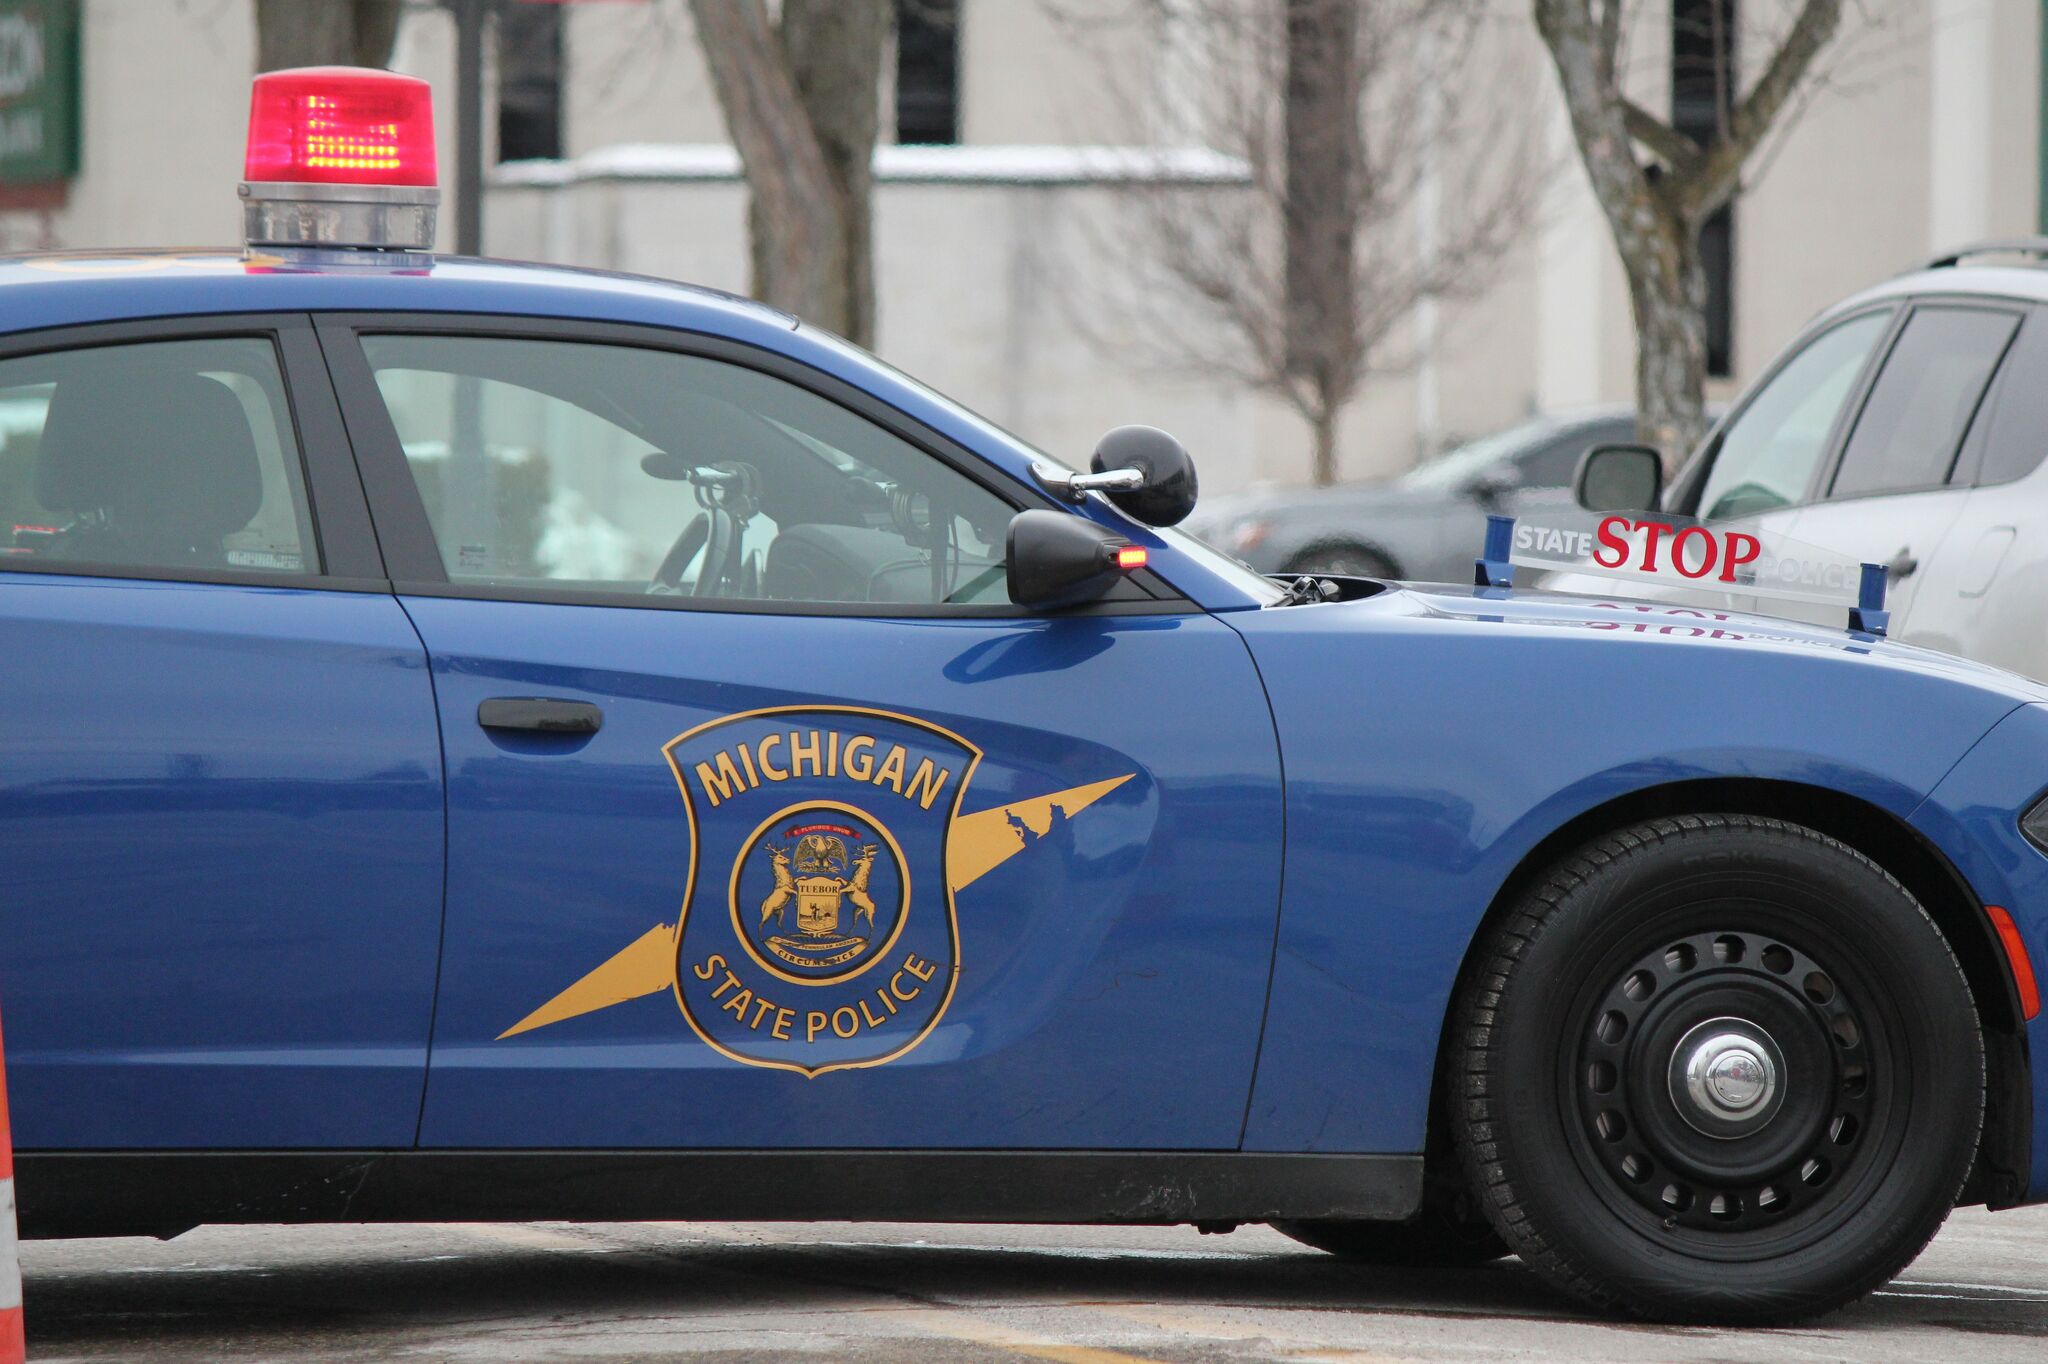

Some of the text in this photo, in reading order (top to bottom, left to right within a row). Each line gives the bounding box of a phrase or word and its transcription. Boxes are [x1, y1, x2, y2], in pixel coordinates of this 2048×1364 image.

[1516, 516, 1858, 591] STATE STOP POLICE
[694, 729, 950, 812] MICHIGAN
[800, 885, 838, 894] TUEBOR
[778, 949, 856, 967] CIRCUMSICE
[693, 952, 937, 1044] STATE POLICE
